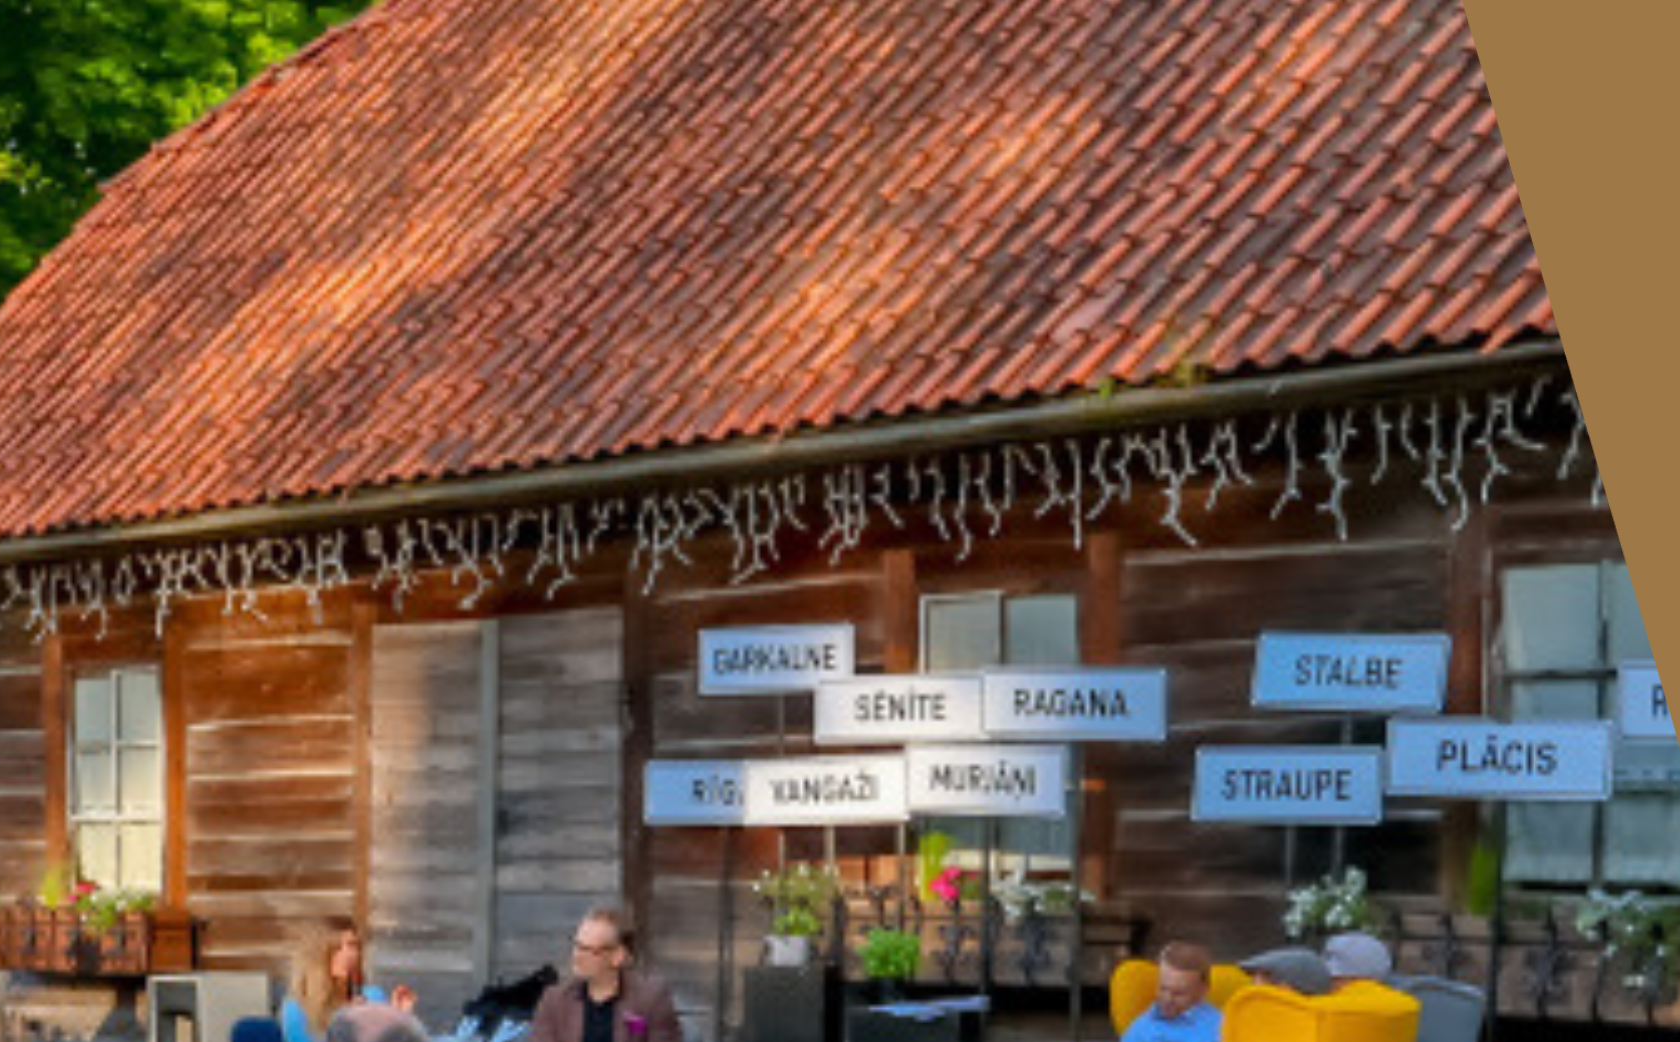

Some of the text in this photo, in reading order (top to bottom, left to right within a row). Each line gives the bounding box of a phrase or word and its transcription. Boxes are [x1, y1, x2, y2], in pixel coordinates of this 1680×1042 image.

[713, 643, 838, 676] GARKALNE
[1293, 653, 1404, 690] STALBE
[854, 685, 948, 722] SĒNĪTE
[1013, 688, 1130, 718] RAGANA
[1436, 734, 1559, 776] PLĀCIS
[692, 775, 744, 805] RĪG
[770, 769, 880, 803] VANGAŽI
[929, 760, 1037, 799] MURJĀŅI
[1221, 768, 1353, 801] STRAUPE
